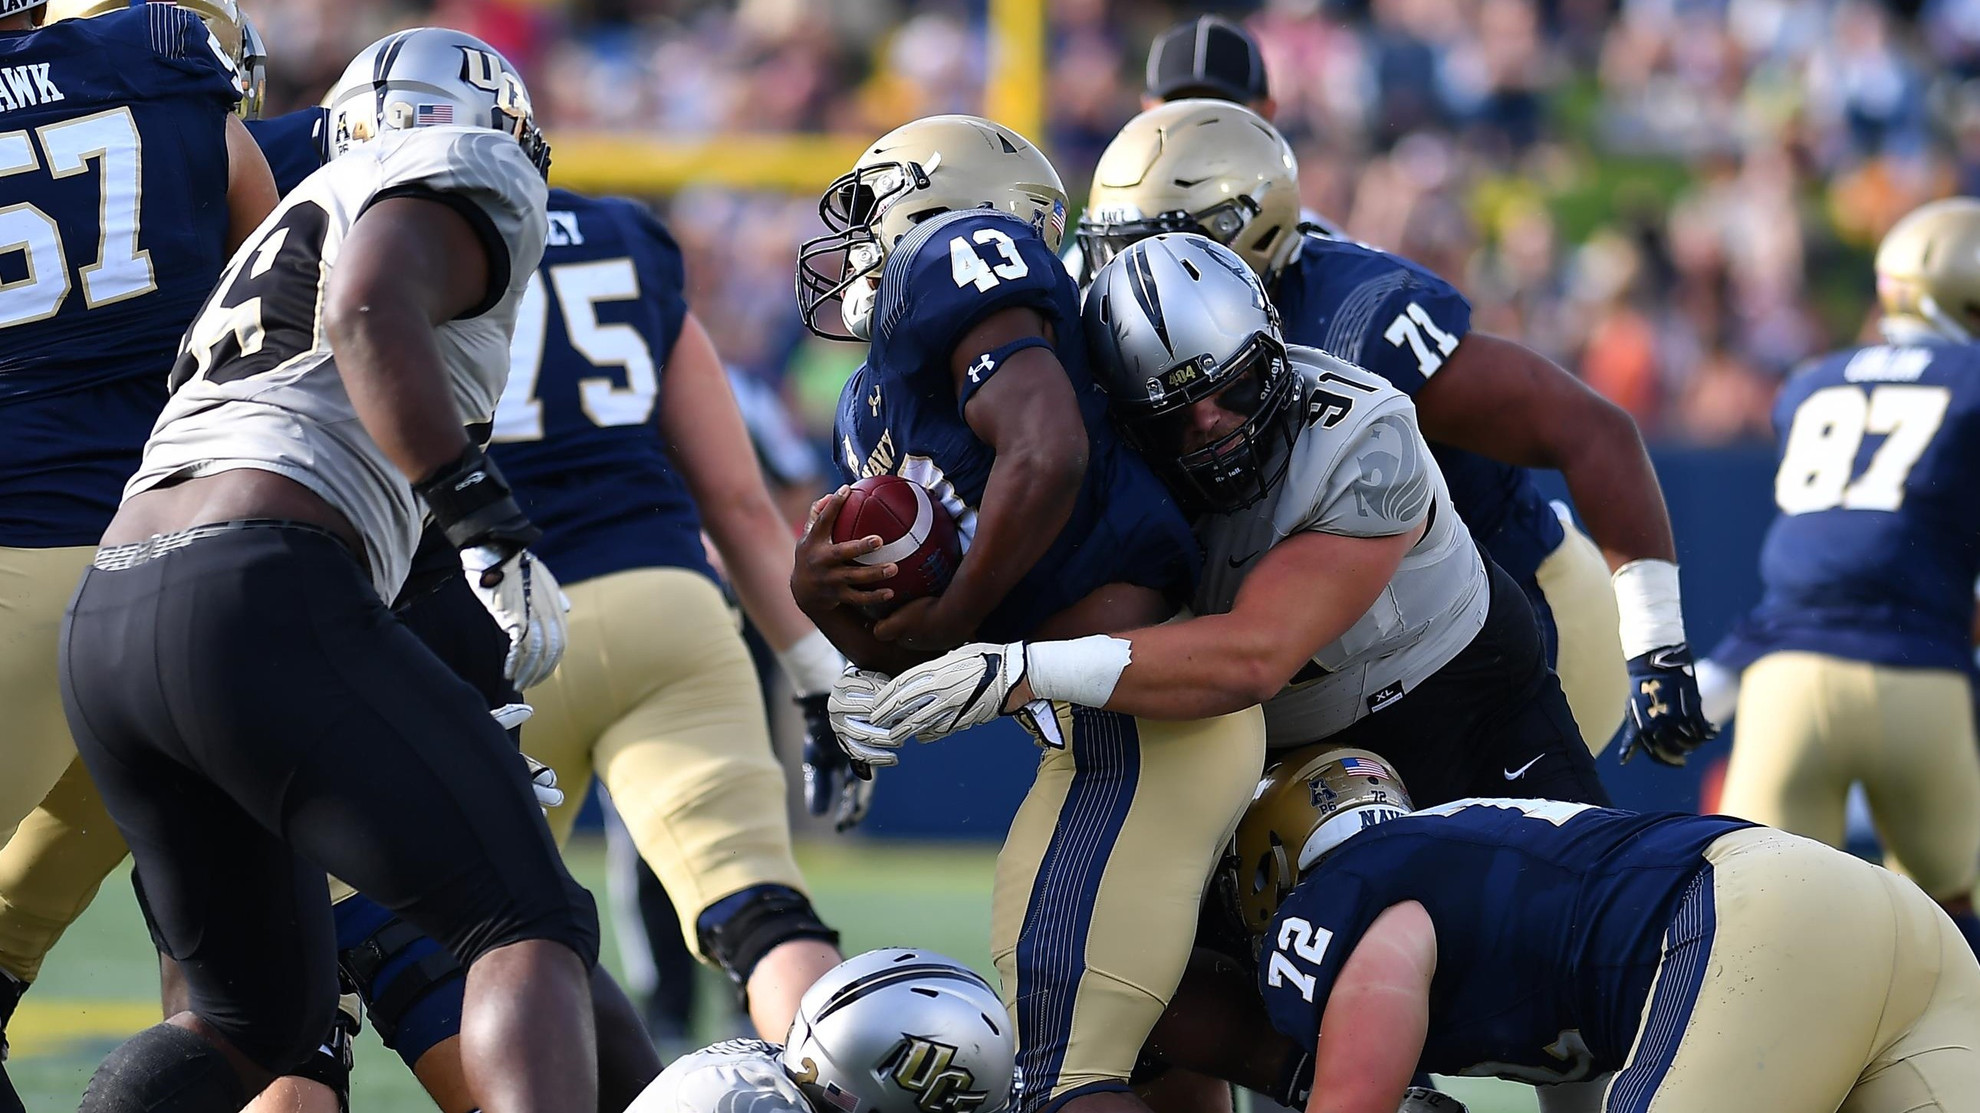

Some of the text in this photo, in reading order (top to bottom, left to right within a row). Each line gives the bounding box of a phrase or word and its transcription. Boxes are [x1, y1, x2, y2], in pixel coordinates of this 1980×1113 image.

[0, 105, 158, 328] 57
[950, 228, 1029, 293] 43
[488, 257, 659, 443] 75
[1383, 302, 1459, 379] 71
[1169, 365, 1196, 386] 404
[1308, 371, 1380, 430] 91
[1775, 385, 1950, 516] 87
[1376, 690, 1394, 702] XL
[1358, 809, 1404, 829] NAV
[1371, 790, 1387, 803] 72
[1268, 917, 1333, 1003] 72
